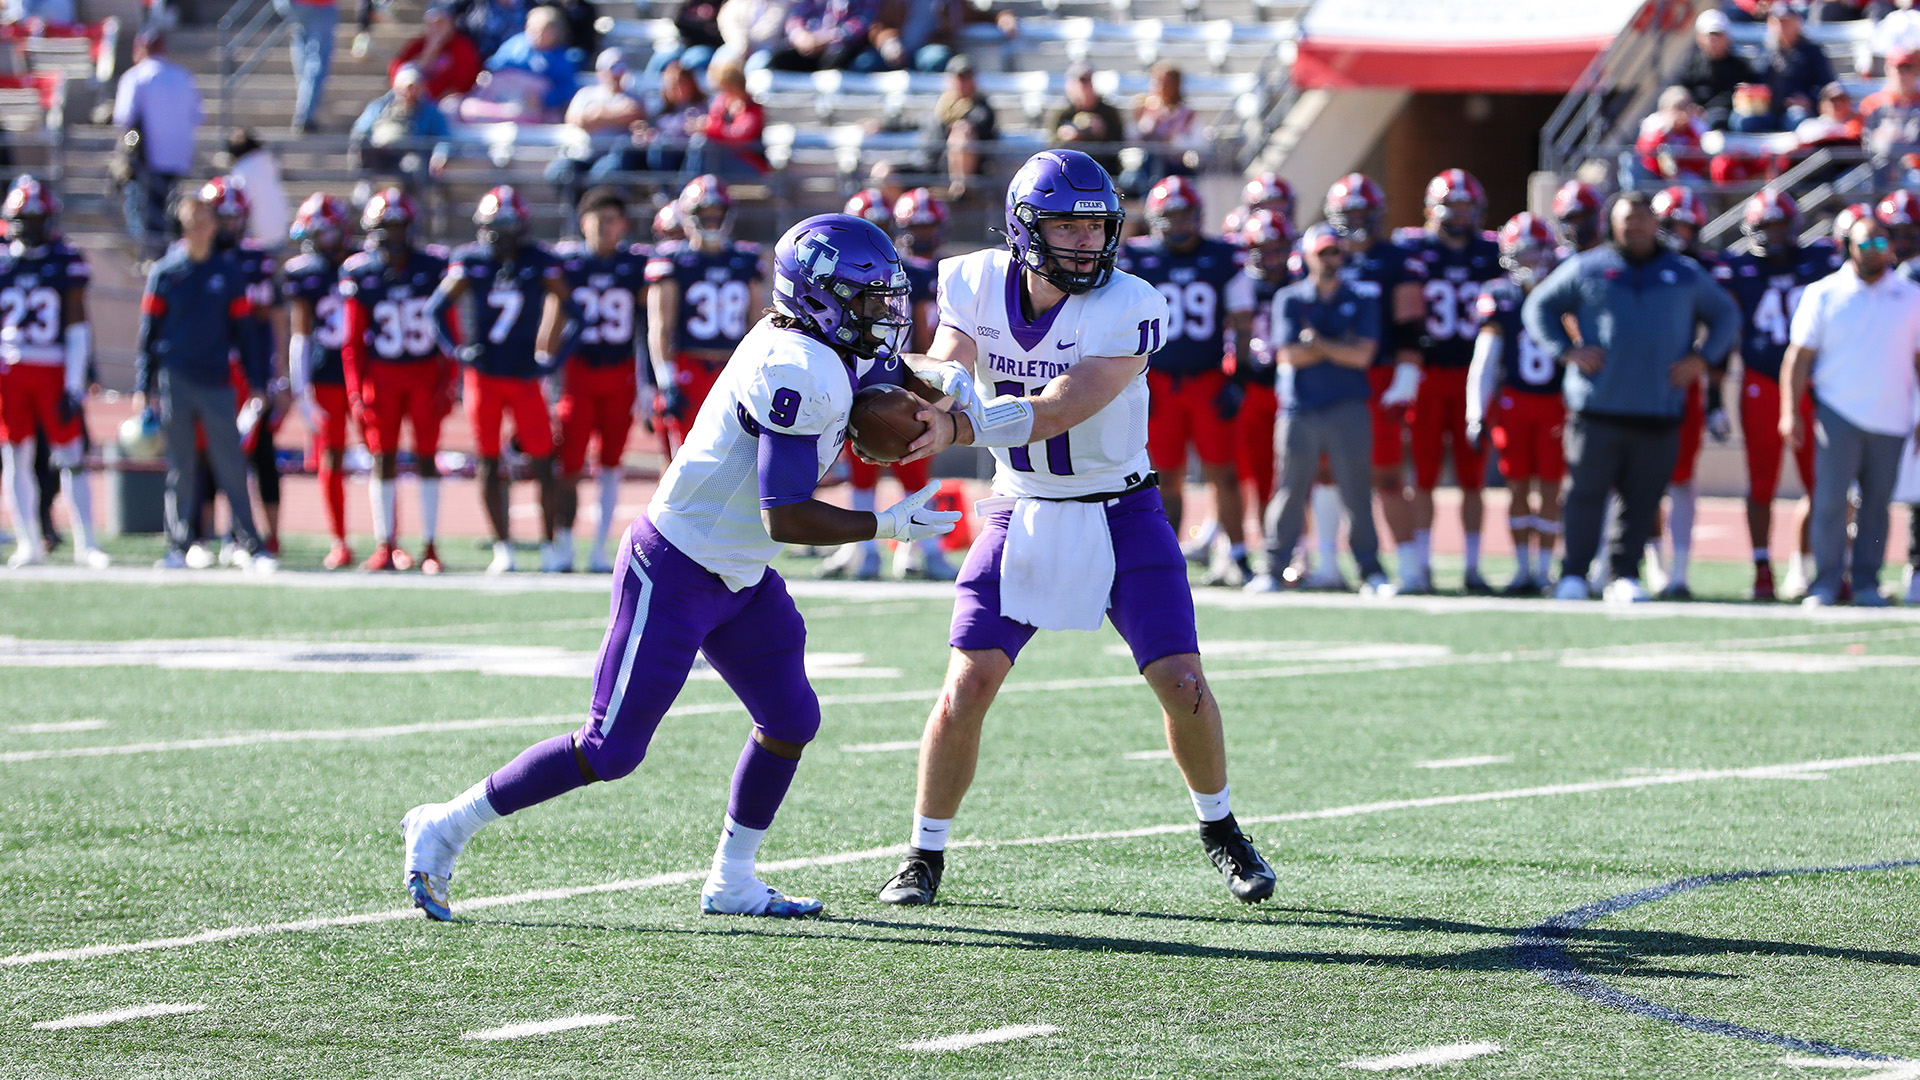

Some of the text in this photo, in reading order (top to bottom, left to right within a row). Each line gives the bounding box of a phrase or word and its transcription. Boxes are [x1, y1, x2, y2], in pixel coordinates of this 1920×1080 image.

[1079, 201, 1103, 209] TEXANS
[0, 286, 60, 343] 23
[373, 297, 437, 359] 35
[486, 289, 525, 344] 7
[686, 280, 749, 341] 38
[977, 325, 1000, 340] WAC
[1135, 318, 1160, 356] 11
[768, 387, 802, 428] 9
